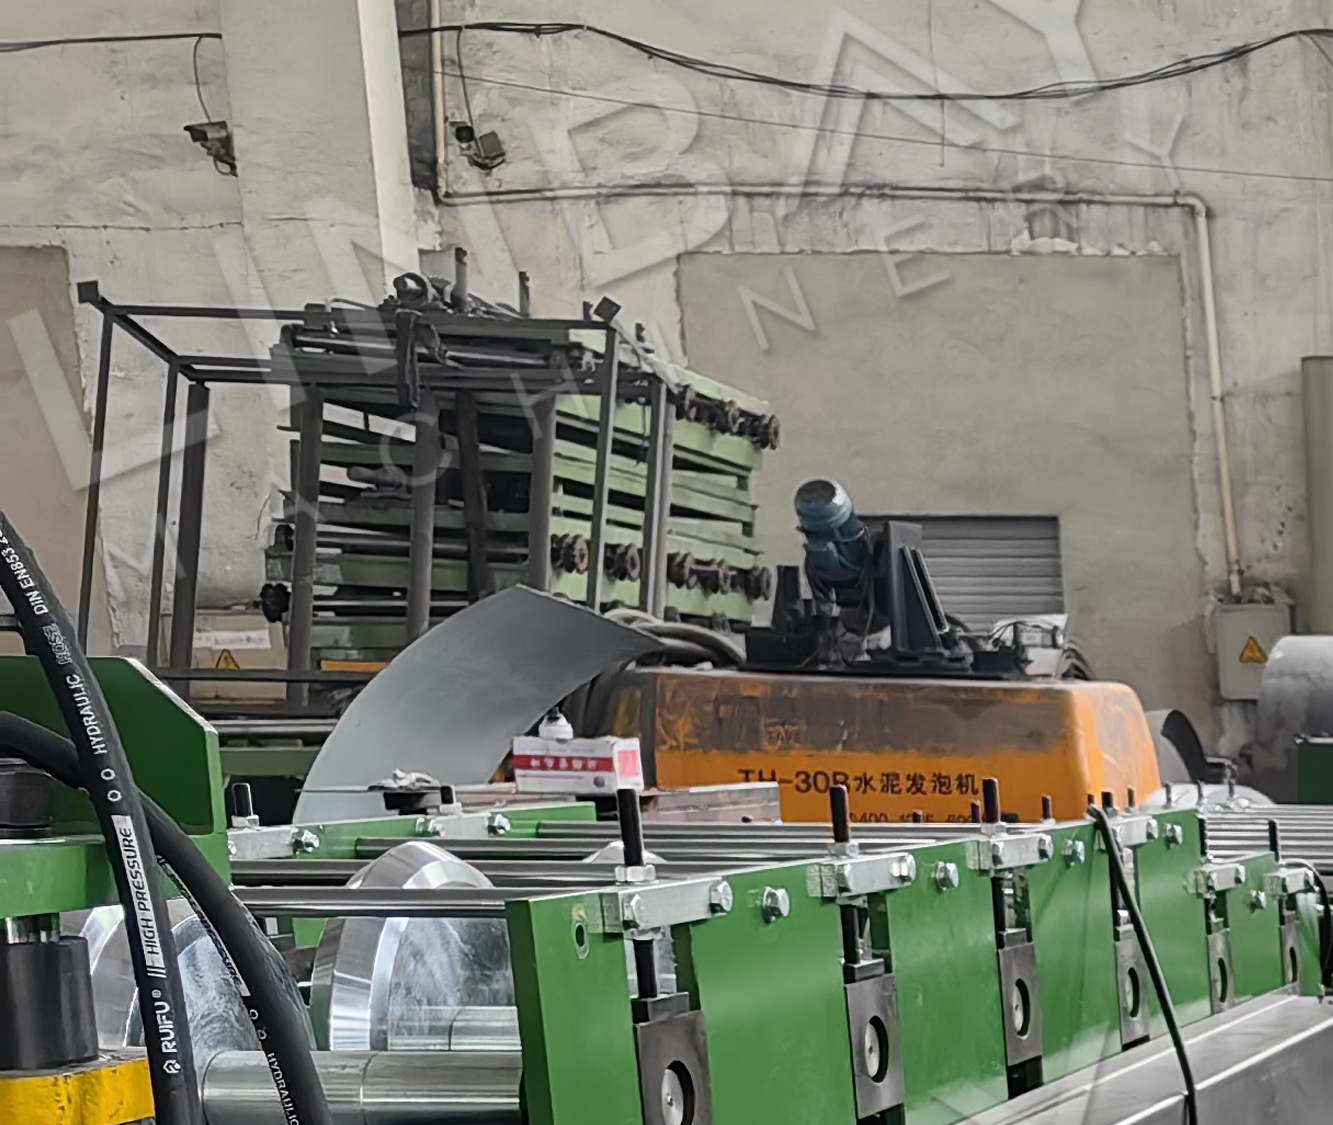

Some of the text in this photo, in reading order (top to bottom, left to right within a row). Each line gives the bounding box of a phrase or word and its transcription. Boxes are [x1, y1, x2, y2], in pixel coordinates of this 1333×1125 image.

[1, 546, 35, 589] EN853
[26, 590, 49, 616] DIN
[66, 673, 107, 755] HYDRAULIC
[119, 826, 151, 917] PRESSURE
[138, 916, 162, 957] HIGH
